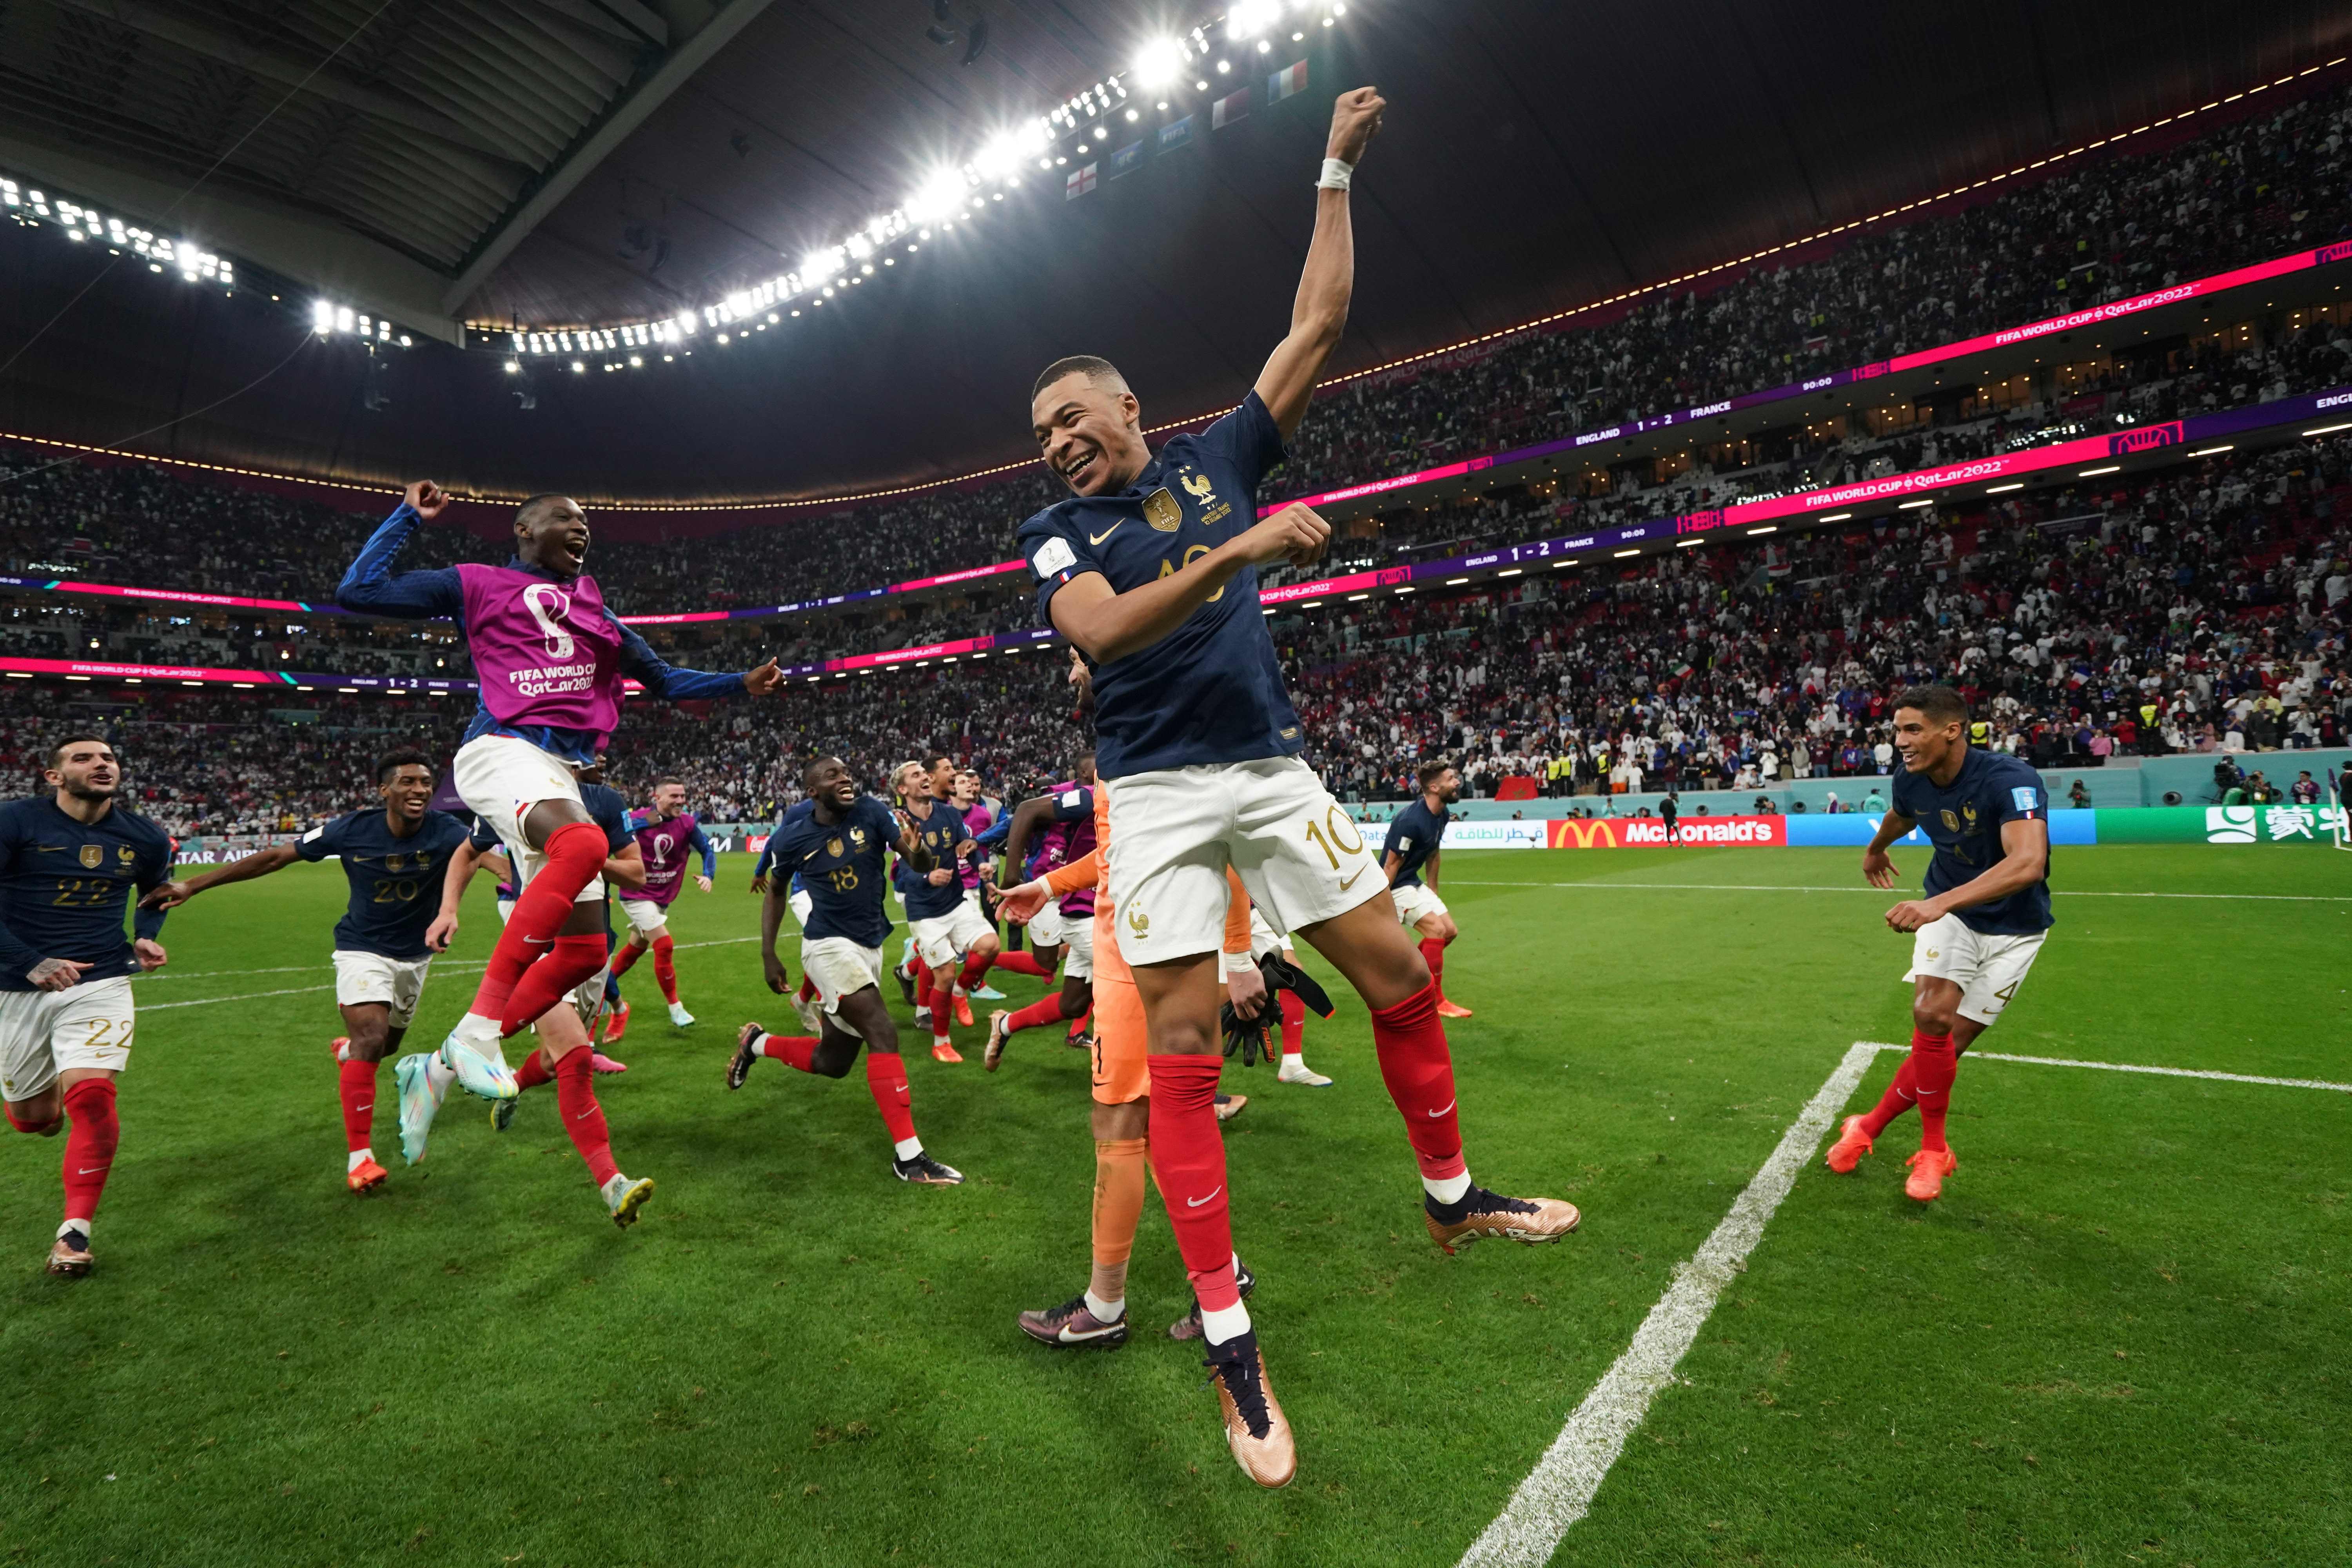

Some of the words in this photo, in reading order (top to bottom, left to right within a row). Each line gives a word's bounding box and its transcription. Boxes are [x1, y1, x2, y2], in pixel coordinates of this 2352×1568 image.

[1996, 331, 2022, 344] FIFA
[2022, 319, 2066, 337] WORLD
[2068, 312, 2092, 325] CUP
[1576, 428, 1620, 446] ENGLAND
[1637, 421, 1644, 431] 1
[1664, 414, 1673, 425] 2
[1690, 401, 1731, 419] FRANCE
[1802, 377, 1832, 391] 90:00
[1359, 485, 1372, 494] CUP
[1806, 494, 1832, 506] FIFA
[1832, 485, 1877, 501] WORLD
[1878, 480, 1902, 493] CUP
[1161, 515, 1175, 525] FIFA
[1465, 555, 1498, 566] ENGLAND
[1512, 547, 1519, 561] 1
[1539, 542, 1550, 556] 2
[1564, 537, 1594, 549] FRANCE
[1621, 528, 1646, 539] 90:00
[1266, 592, 1280, 600] CUP
[389, 678, 395, 687] 1
[410, 679, 418, 688] 2
[510, 668, 544, 683] FIFA
[544, 665, 584, 679] WORLD
[1306, 805, 1363, 870] 10
[53, 878, 113, 906] 22
[374, 879, 418, 903] 20
[828, 865, 858, 893] 18
[1994, 980, 2020, 1007] 4
[85, 1018, 134, 1049] 22
[1261, 1027, 1276, 1062] reusch
